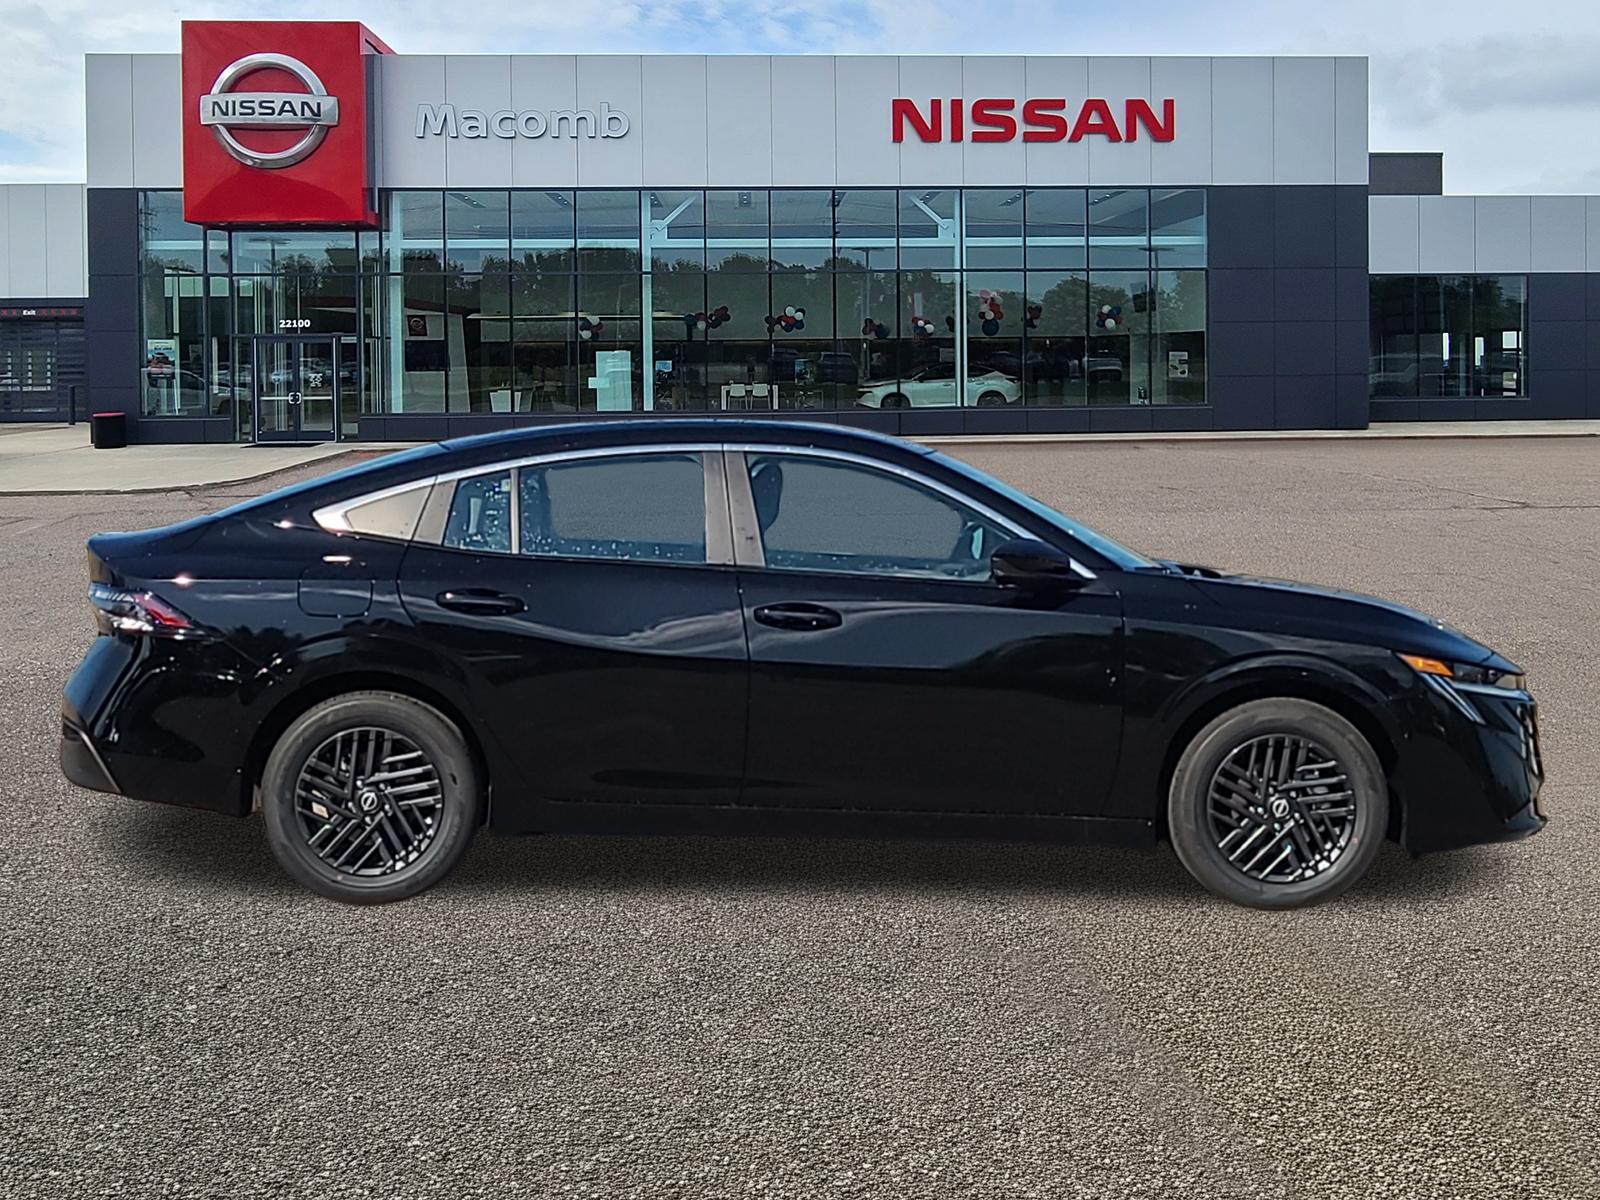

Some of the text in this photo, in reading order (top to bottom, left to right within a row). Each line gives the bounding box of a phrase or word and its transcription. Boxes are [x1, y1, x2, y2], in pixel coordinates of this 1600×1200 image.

[211, 99, 322, 118] NISSAN
[414, 102, 630, 139] Macomb
[891, 98, 1175, 143] NISSAN
[279, 319, 311, 328] 22100
